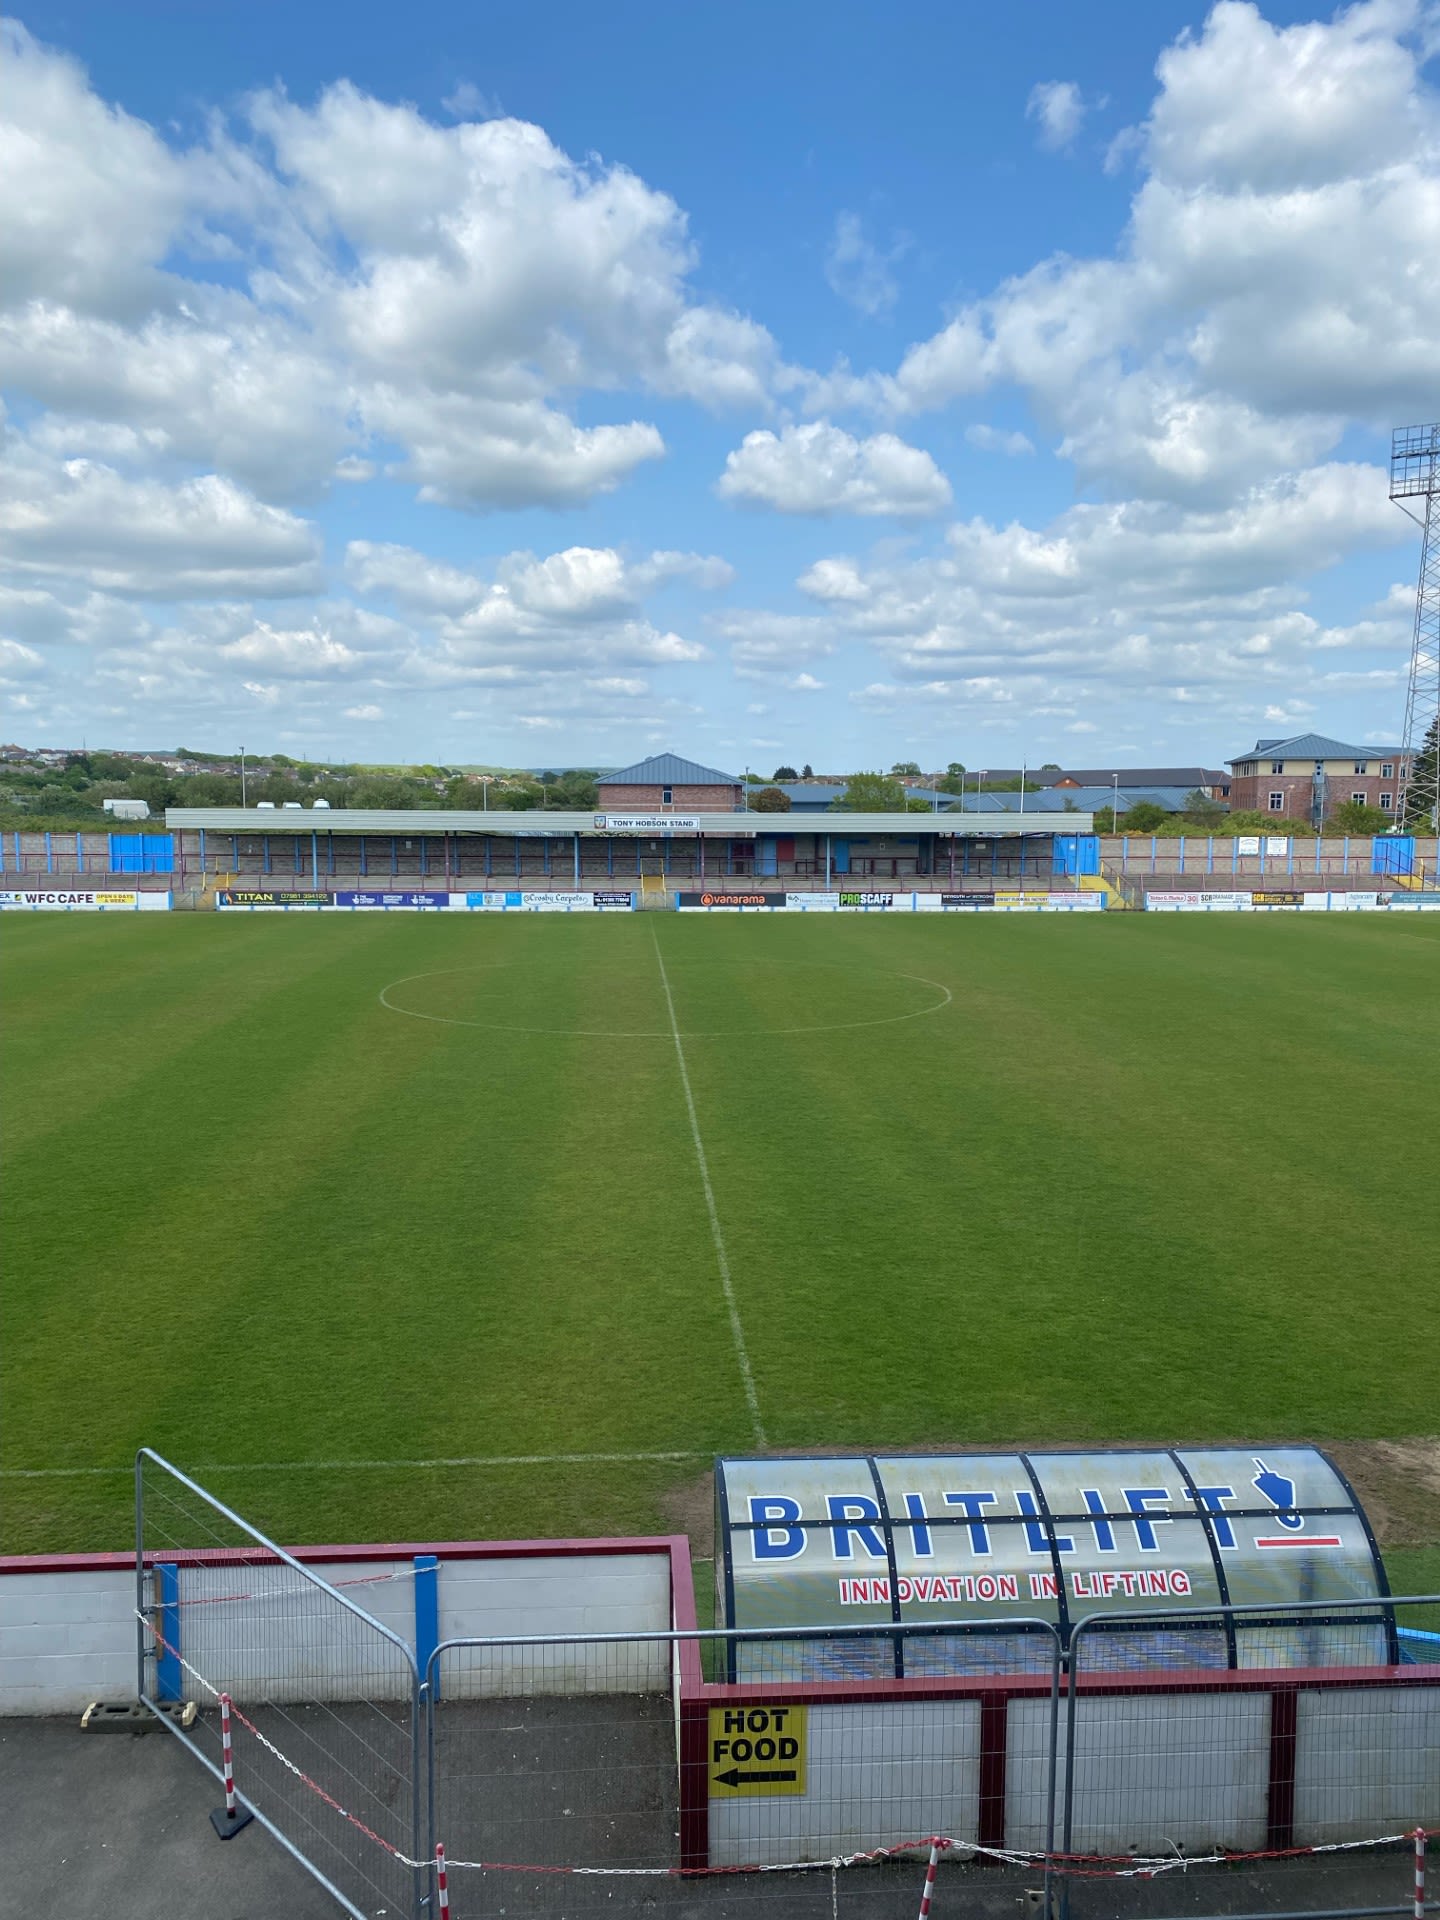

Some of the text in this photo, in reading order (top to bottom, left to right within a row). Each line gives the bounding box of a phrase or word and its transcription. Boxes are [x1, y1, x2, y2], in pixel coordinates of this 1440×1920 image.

[25, 893, 56, 903] WFC
[58, 893, 94, 903] CAFE
[528, 894, 554, 902] Crosby
[714, 895, 765, 904] vanarama
[748, 1486, 1238, 1561] BRITLIFT
[839, 1568, 1192, 1604] INNOVATION IN LIFTING
[724, 1709, 789, 1733] HOT
[713, 1737, 799, 1762] FOOD
